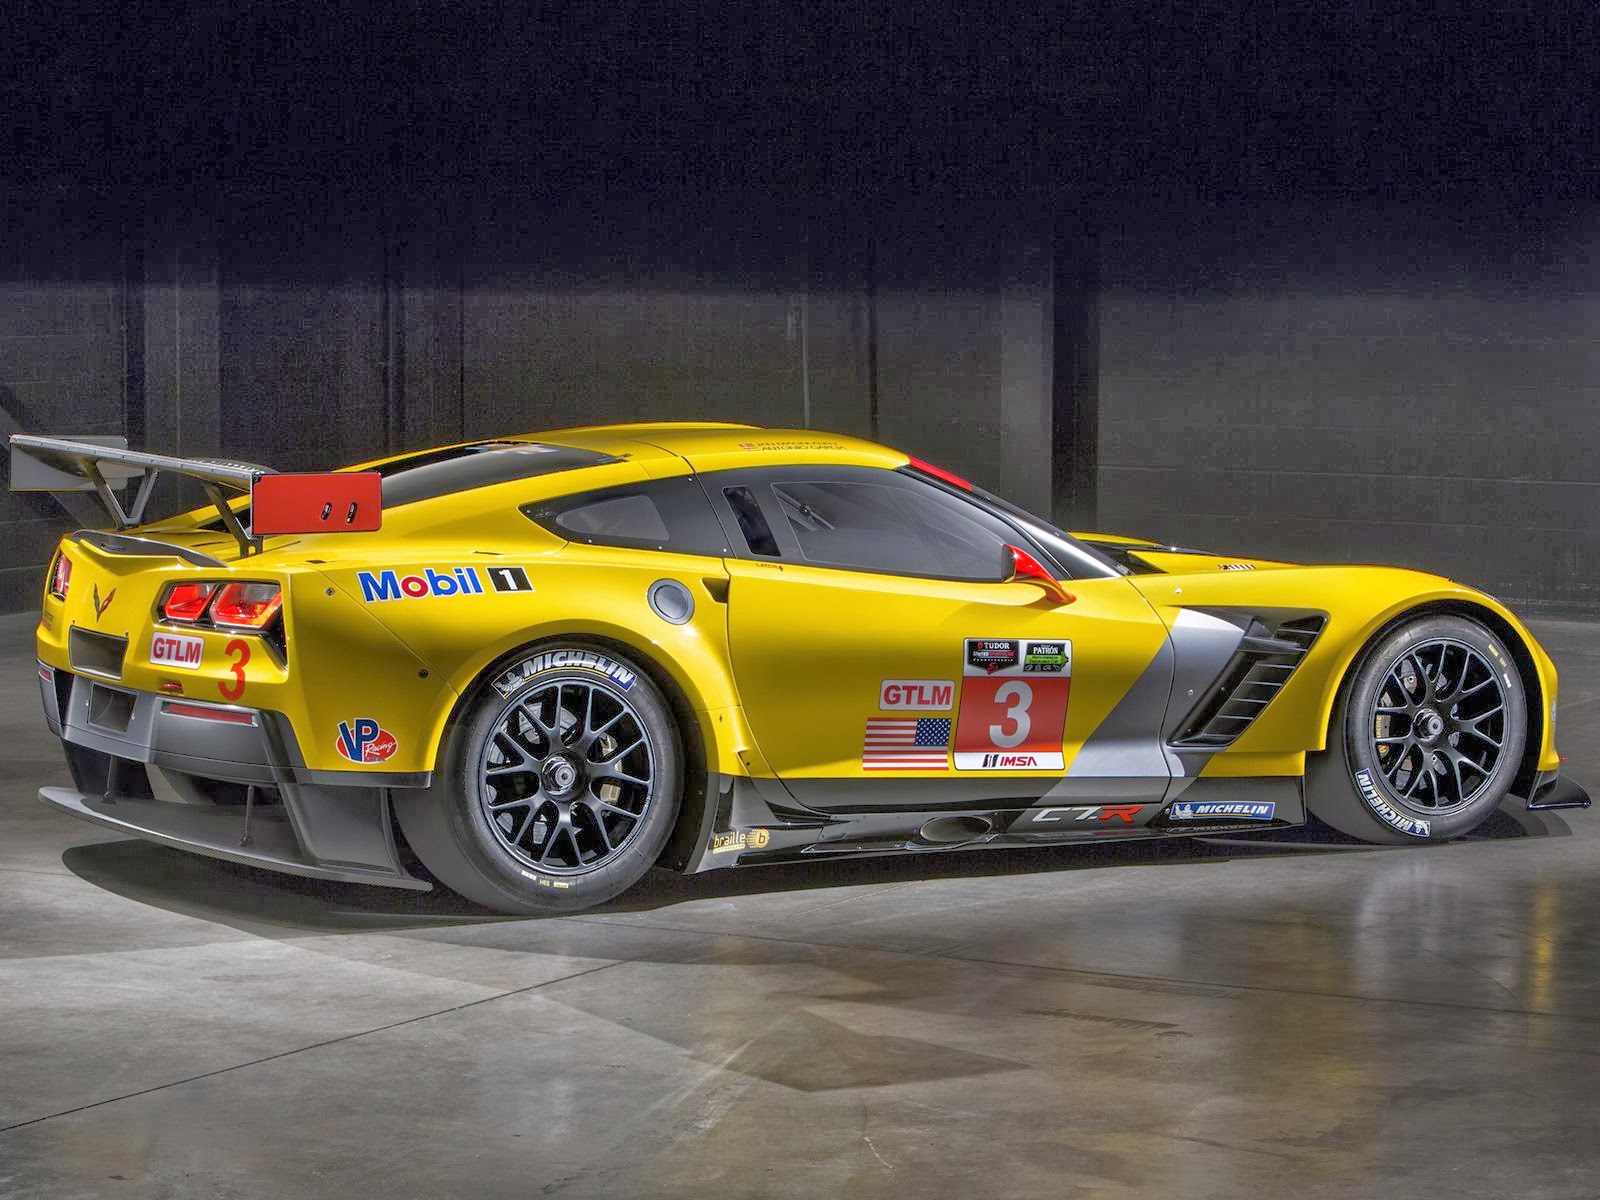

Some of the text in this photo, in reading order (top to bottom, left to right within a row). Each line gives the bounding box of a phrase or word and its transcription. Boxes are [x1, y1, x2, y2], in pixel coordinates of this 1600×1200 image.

[357, 567, 518, 602] Mobil 1
[153, 637, 202, 664] GTLM
[984, 642, 1010, 650] TUDOR
[218, 638, 251, 702] 3
[521, 651, 634, 685] MICHELIN
[883, 685, 951, 706] GTLM
[989, 680, 1033, 748] 3
[336, 717, 380, 763] VP
[364, 741, 397, 757] Racing
[1000, 756, 1038, 767] IMSA
[1196, 804, 1269, 815] MICHELIN
[1357, 773, 1413, 832] MICHELIN
[713, 831, 746, 849] braille
